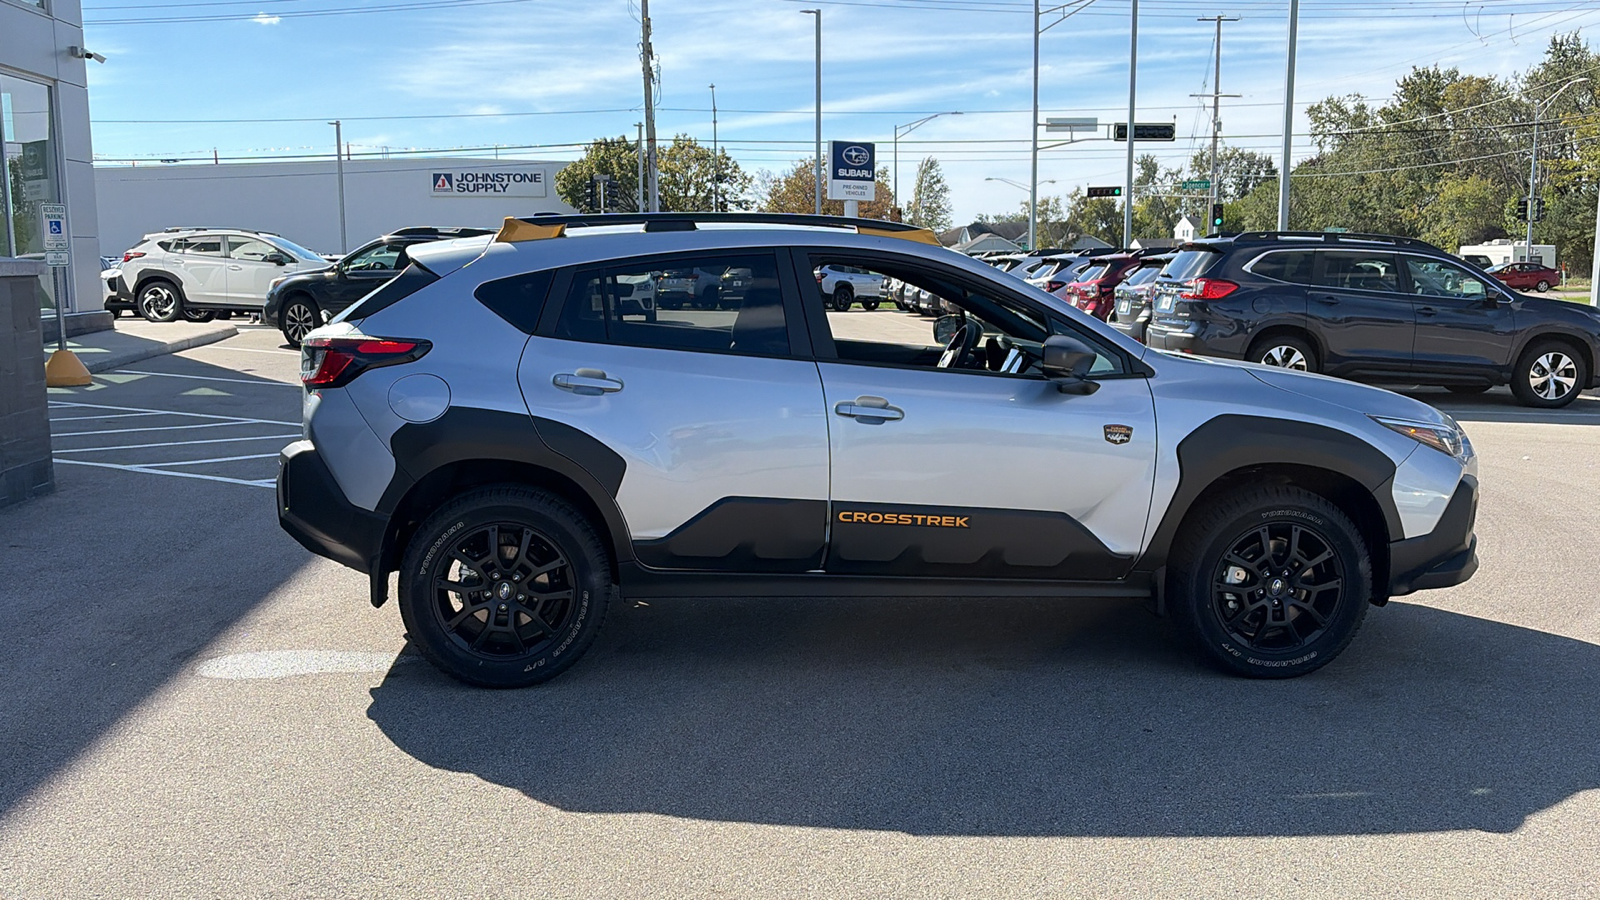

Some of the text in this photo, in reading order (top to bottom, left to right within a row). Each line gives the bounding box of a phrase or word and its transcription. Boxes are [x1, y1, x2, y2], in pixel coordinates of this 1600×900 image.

[455, 173, 542, 183] JOHNSTONE
[838, 168, 872, 178] SUBARU
[456, 183, 509, 193] SUPPLY
[838, 511, 970, 528] CROSSTREK
[1261, 509, 1324, 526] YOKOHAMA
[419, 521, 465, 575] YOKOHAMA
